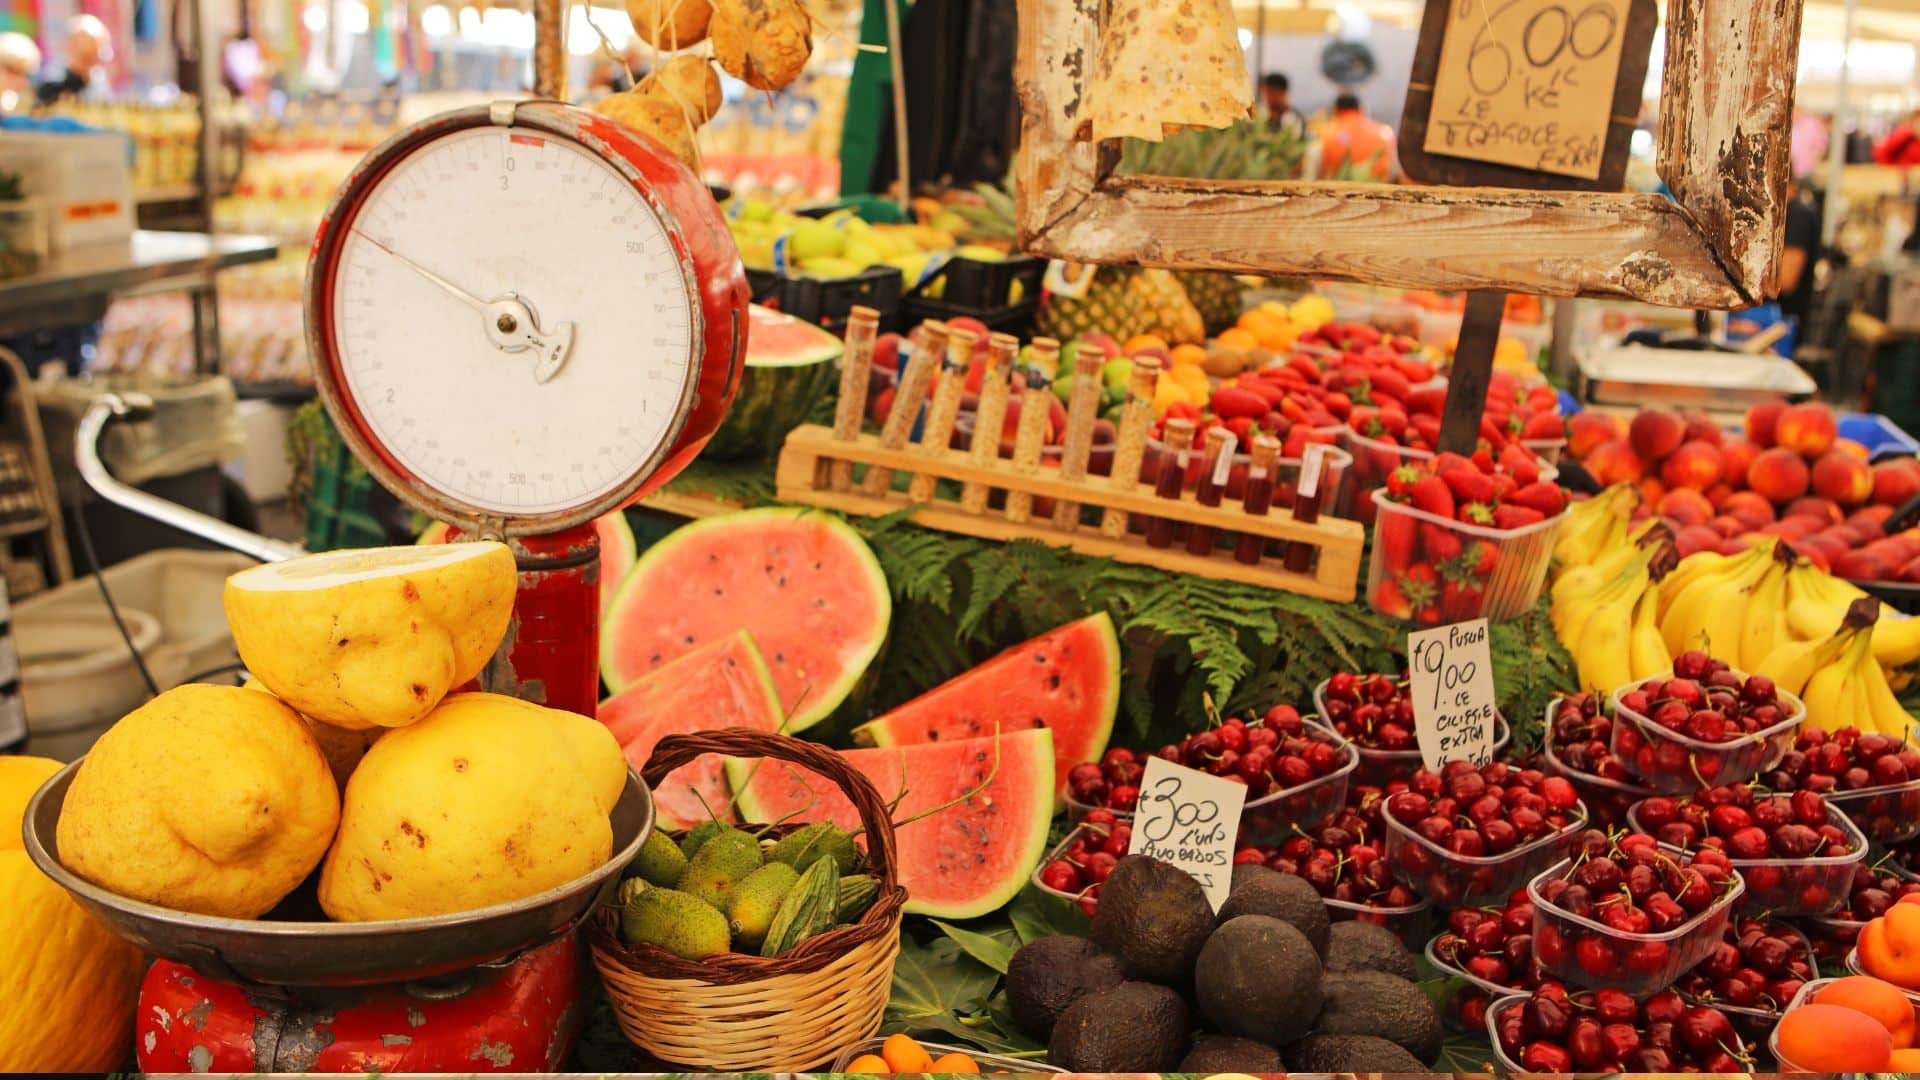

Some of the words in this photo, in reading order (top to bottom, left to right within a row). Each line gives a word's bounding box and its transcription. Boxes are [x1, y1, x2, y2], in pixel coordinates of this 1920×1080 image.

[499, 174, 509, 191] 3
[625, 241, 645, 254] 500
[386, 387, 396, 404] 2
[508, 472, 527, 486] 500
